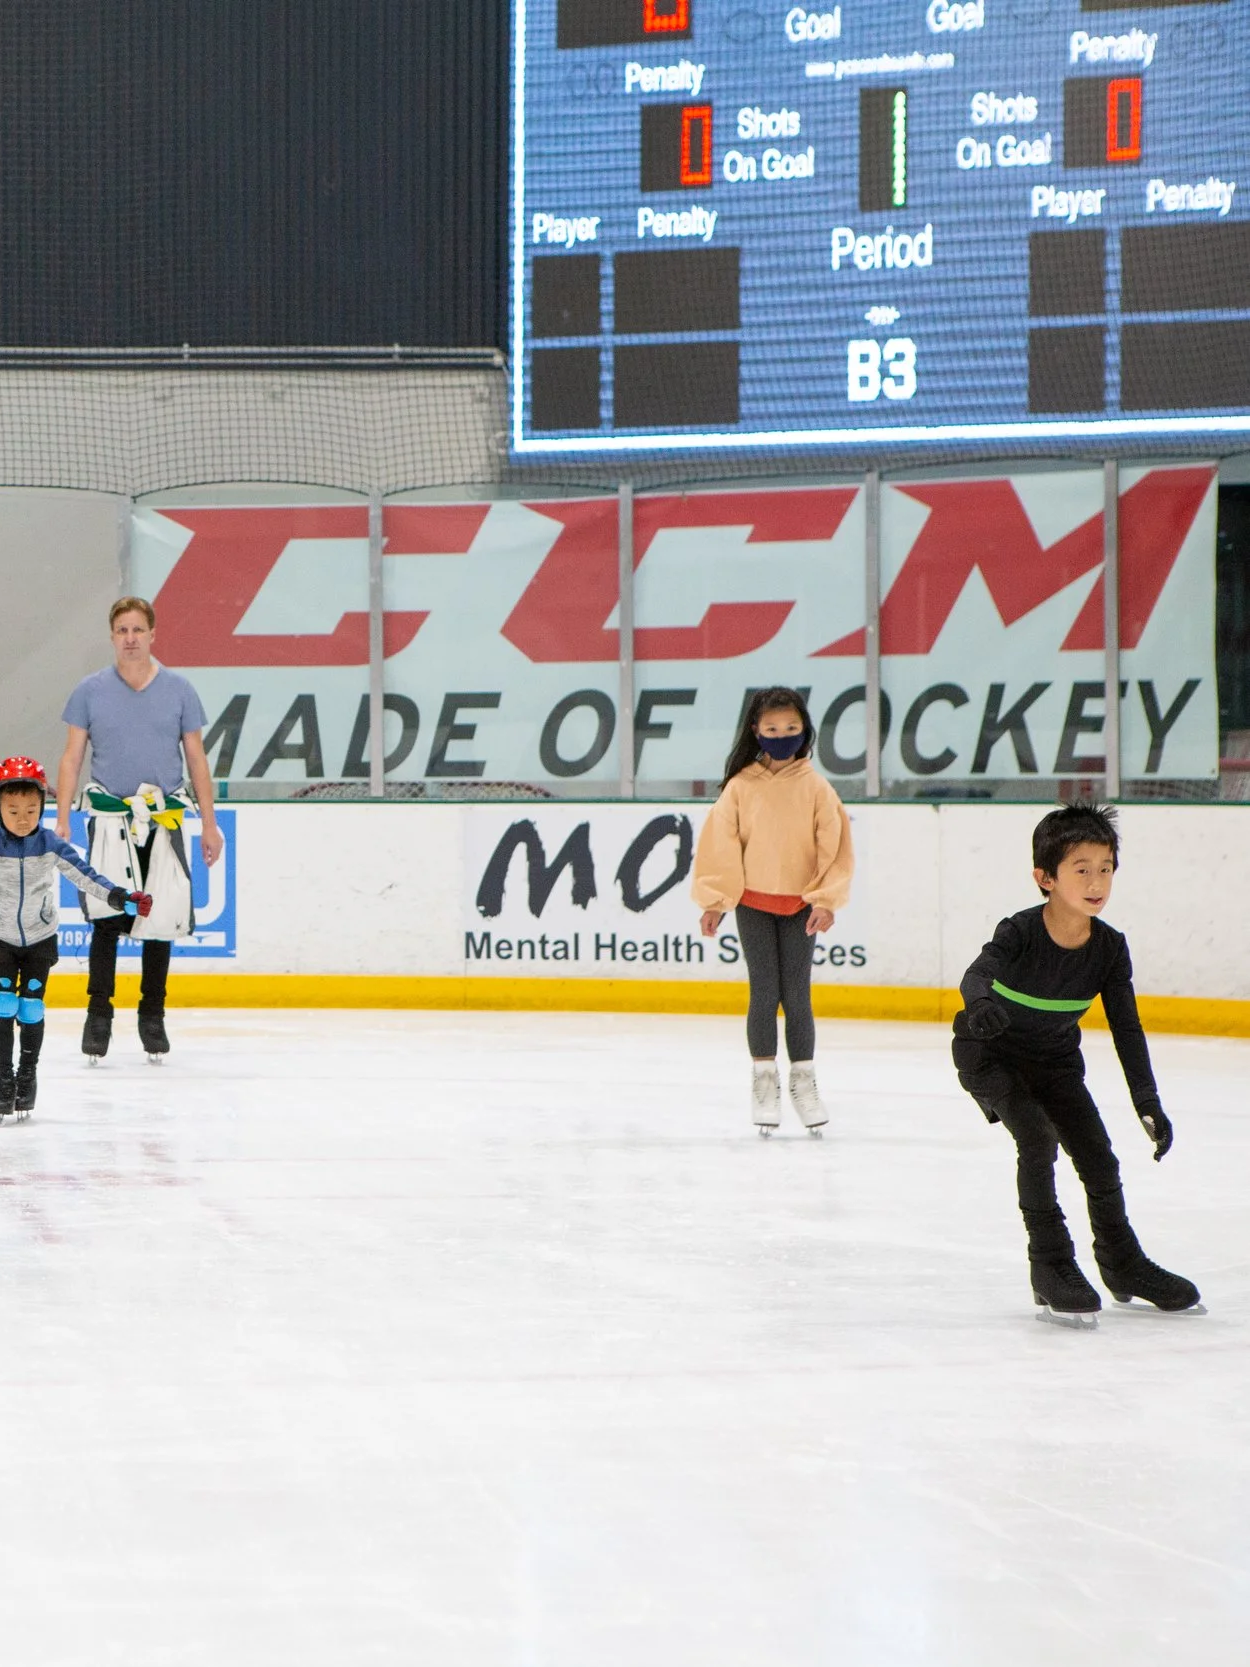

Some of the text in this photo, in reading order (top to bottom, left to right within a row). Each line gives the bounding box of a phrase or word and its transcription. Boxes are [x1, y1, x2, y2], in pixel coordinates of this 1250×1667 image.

[785, 6, 841, 42] Goal
[927, 0, 985, 33] Goal
[1070, 28, 1158, 67] Penalty
[625, 60, 705, 96] Penalty
[737, 107, 800, 139] Shots
[971, 92, 1038, 126] Shots
[1106, 78, 1141, 161] 0
[680, 106, 712, 185] 0
[723, 146, 815, 182] On Goal
[956, 132, 1052, 169] On Goal
[1031, 185, 1106, 223] Player
[1146, 176, 1236, 216] Penalty
[532, 213, 600, 248] Player
[637, 205, 718, 241] Penalty
[831, 223, 933, 270] Period
[847, 338, 917, 401] B3
[148, 466, 1216, 667] CCM
[539, 688, 697, 777] OF
[726, 678, 1202, 777] OCKEY
[464, 931, 580, 961] Mental
[594, 933, 705, 963] Health
